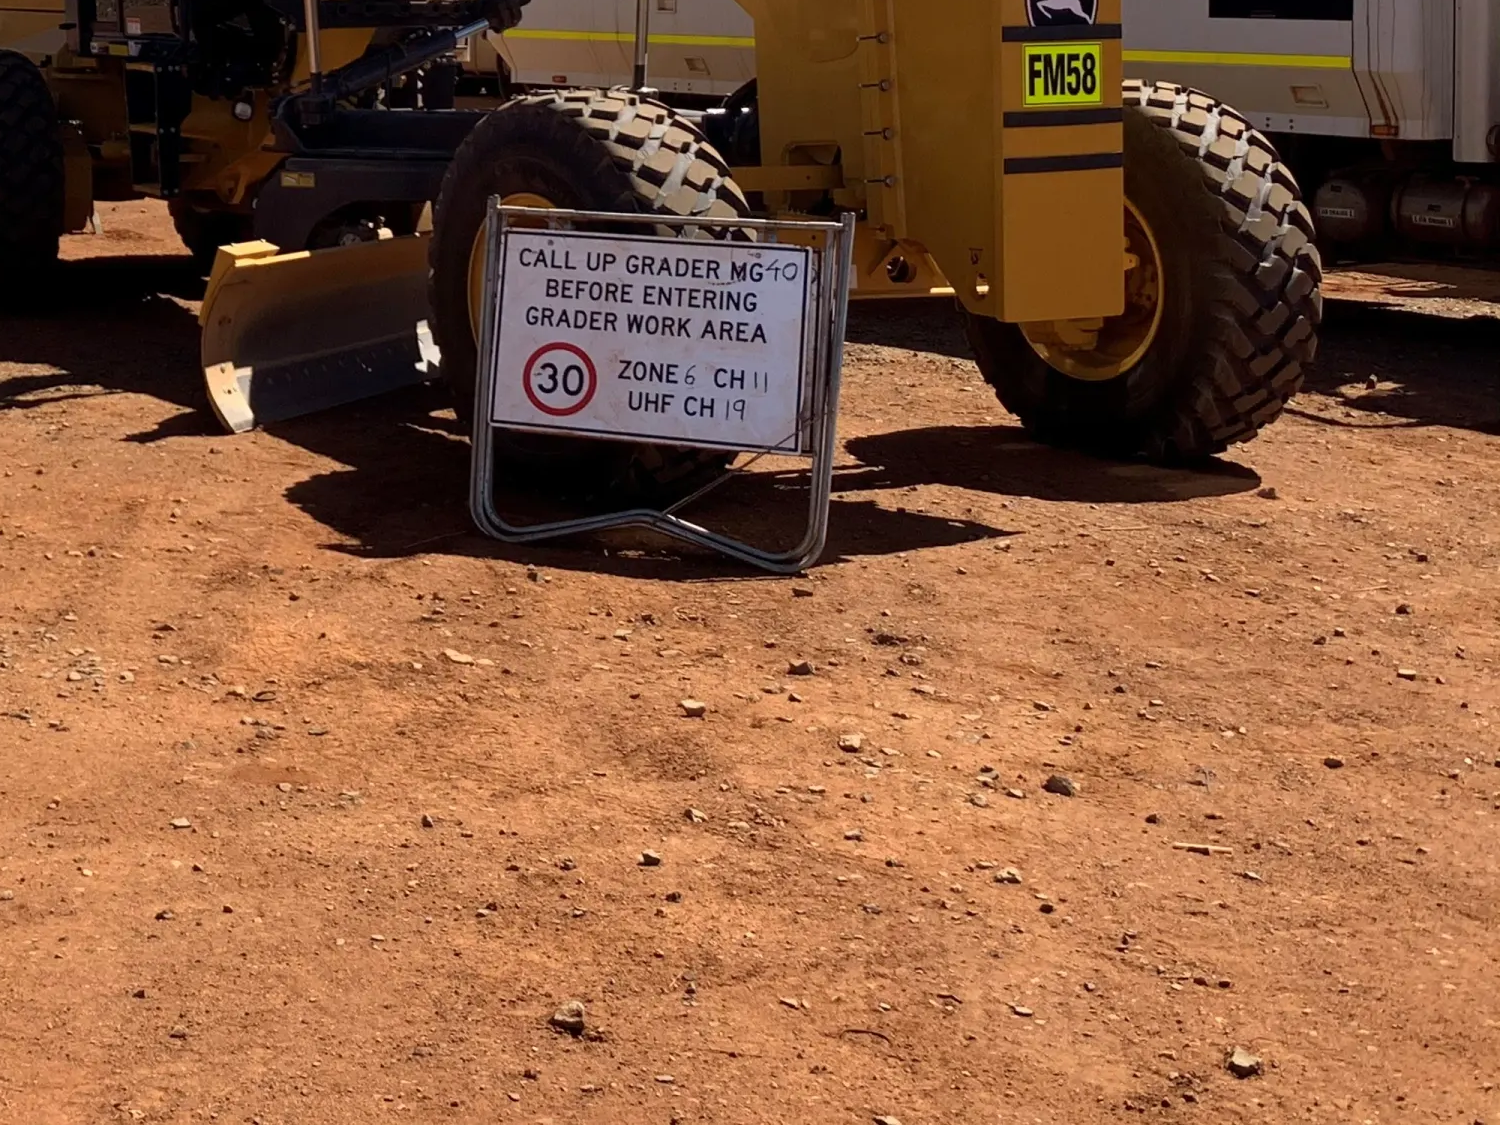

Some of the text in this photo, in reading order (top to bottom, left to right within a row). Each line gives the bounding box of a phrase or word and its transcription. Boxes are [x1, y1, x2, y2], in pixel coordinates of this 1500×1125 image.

[1028, 52, 1097, 97] FM58
[518, 247, 577, 271] CALL
[586, 251, 618, 273] UP
[625, 254, 721, 280] GRADER
[545, 278, 758, 313] BEFORE ENTERING
[525, 306, 768, 344] GRADER WORK AREA
[537, 362, 585, 397] 30
[617, 359, 679, 385] ZONE
[684, 364, 697, 386] 6
[713, 368, 745, 390] CH
[627, 390, 747, 422] UHF CH 19
